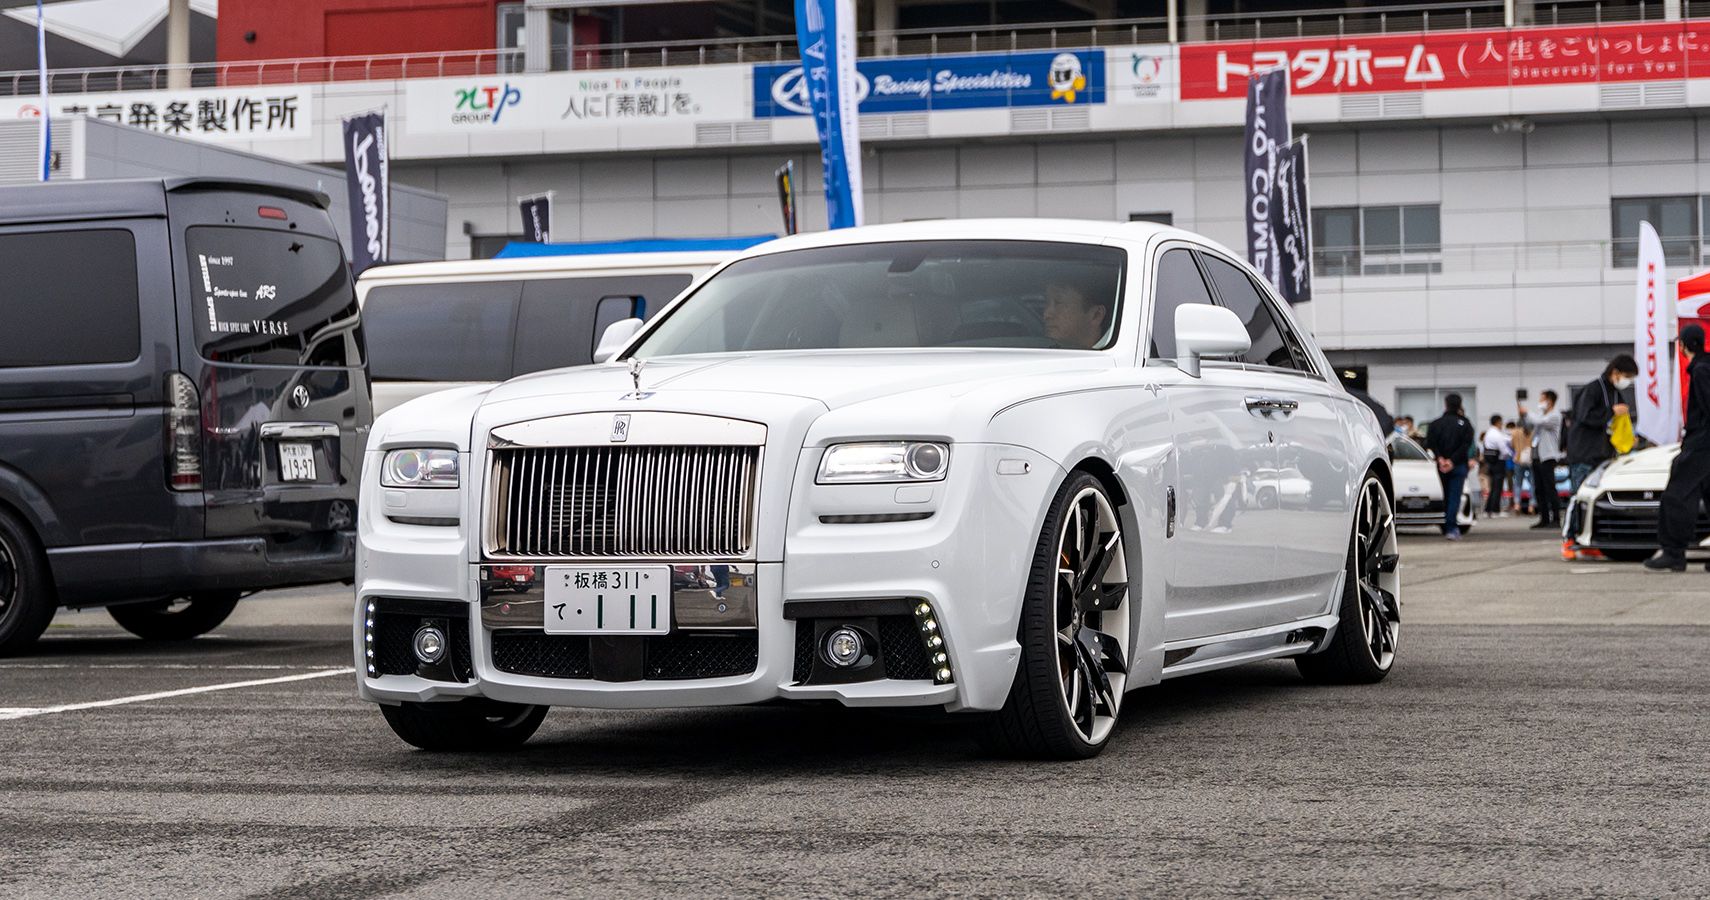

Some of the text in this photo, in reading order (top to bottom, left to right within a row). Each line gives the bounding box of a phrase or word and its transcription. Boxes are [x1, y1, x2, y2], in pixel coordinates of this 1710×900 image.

[1217, 45, 1445, 92] トヨタホーム
[1512, 59, 1677, 79] Sincerely for You
[579, 76, 681, 91] Nice To People
[873, 74, 931, 98] Racing
[452, 112, 491, 124] GROUP
[255, 285, 276, 300] ARS
[253, 320, 289, 335] VERSE
